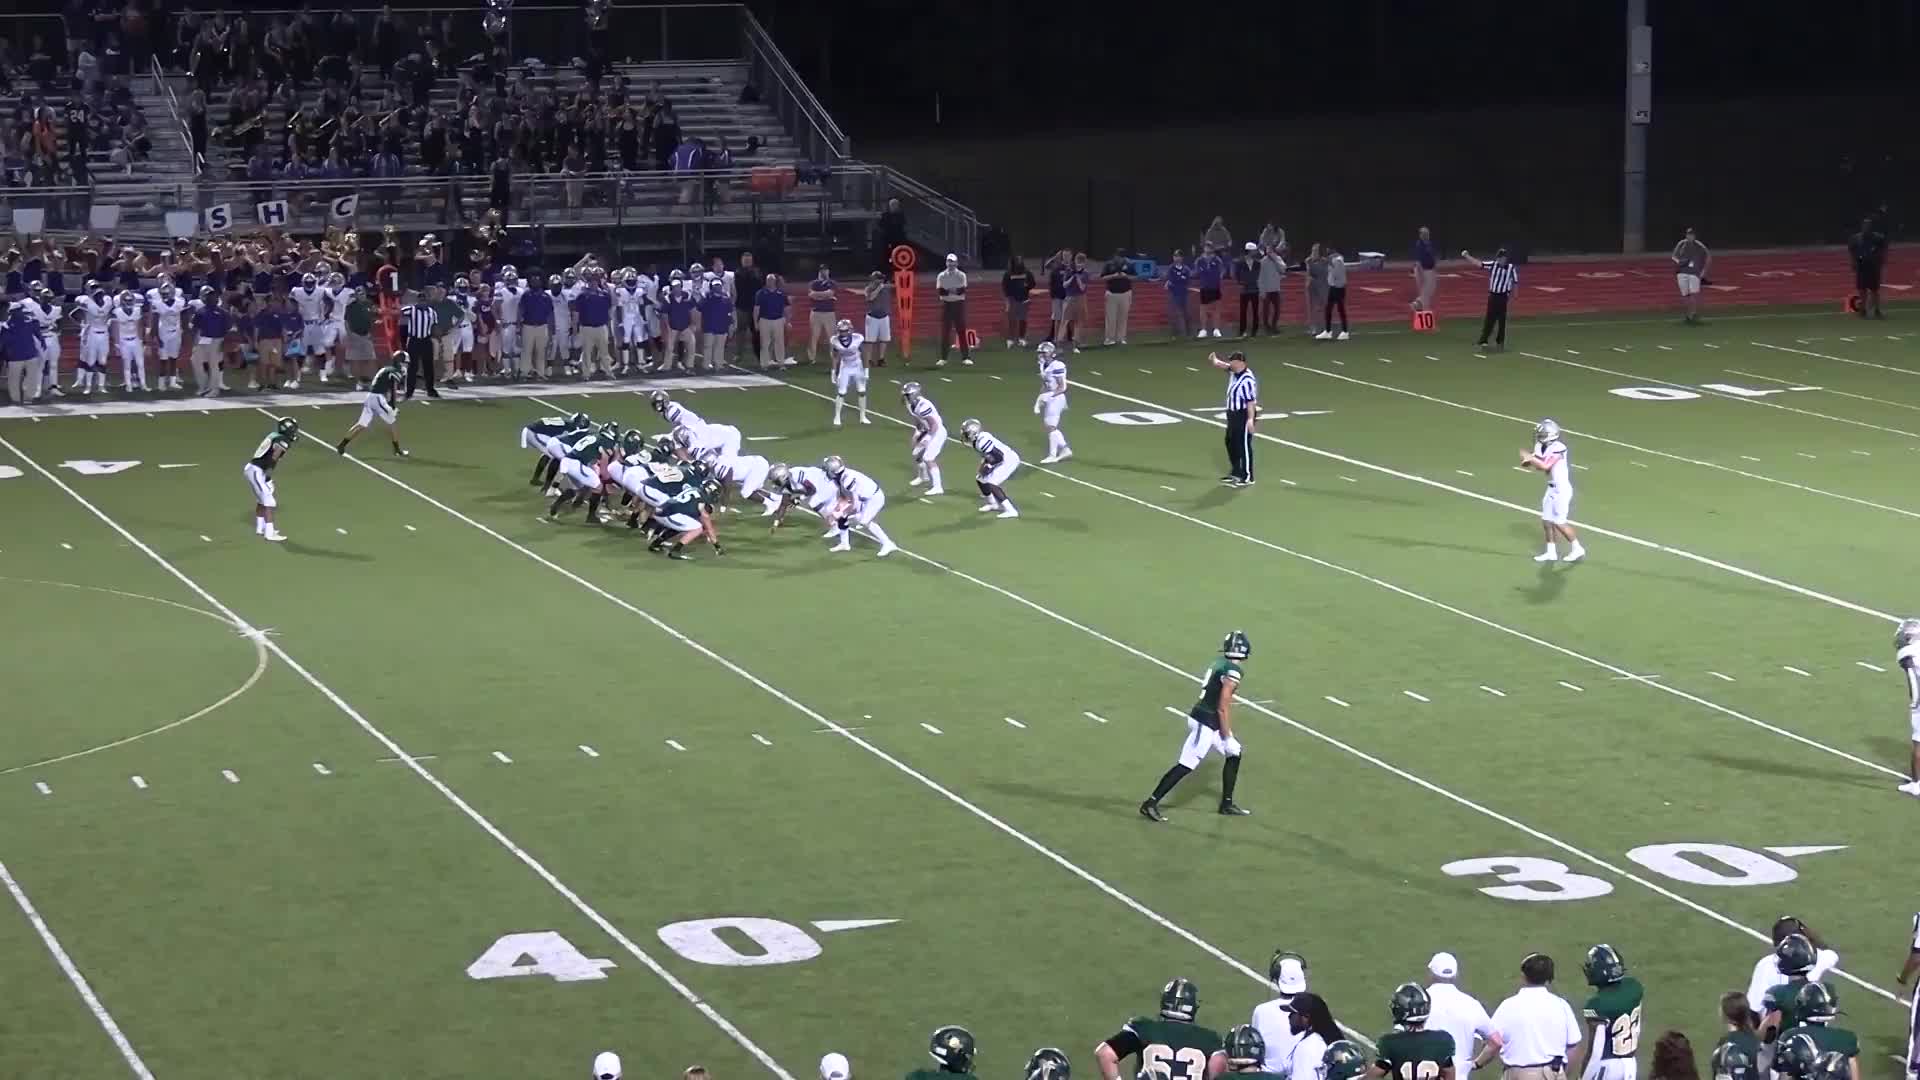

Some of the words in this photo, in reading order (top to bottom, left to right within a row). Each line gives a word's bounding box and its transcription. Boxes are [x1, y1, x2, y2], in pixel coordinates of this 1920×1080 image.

[69, 109, 85, 123] 24
[211, 207, 227, 228] S
[262, 203, 284, 224] H
[335, 198, 352, 216] C
[389, 271, 399, 291] 1
[1417, 312, 1433, 329] 10
[1440, 843, 1798, 901] 30
[465, 917, 823, 982] 40
[1142, 1044, 1206, 1080] 63
